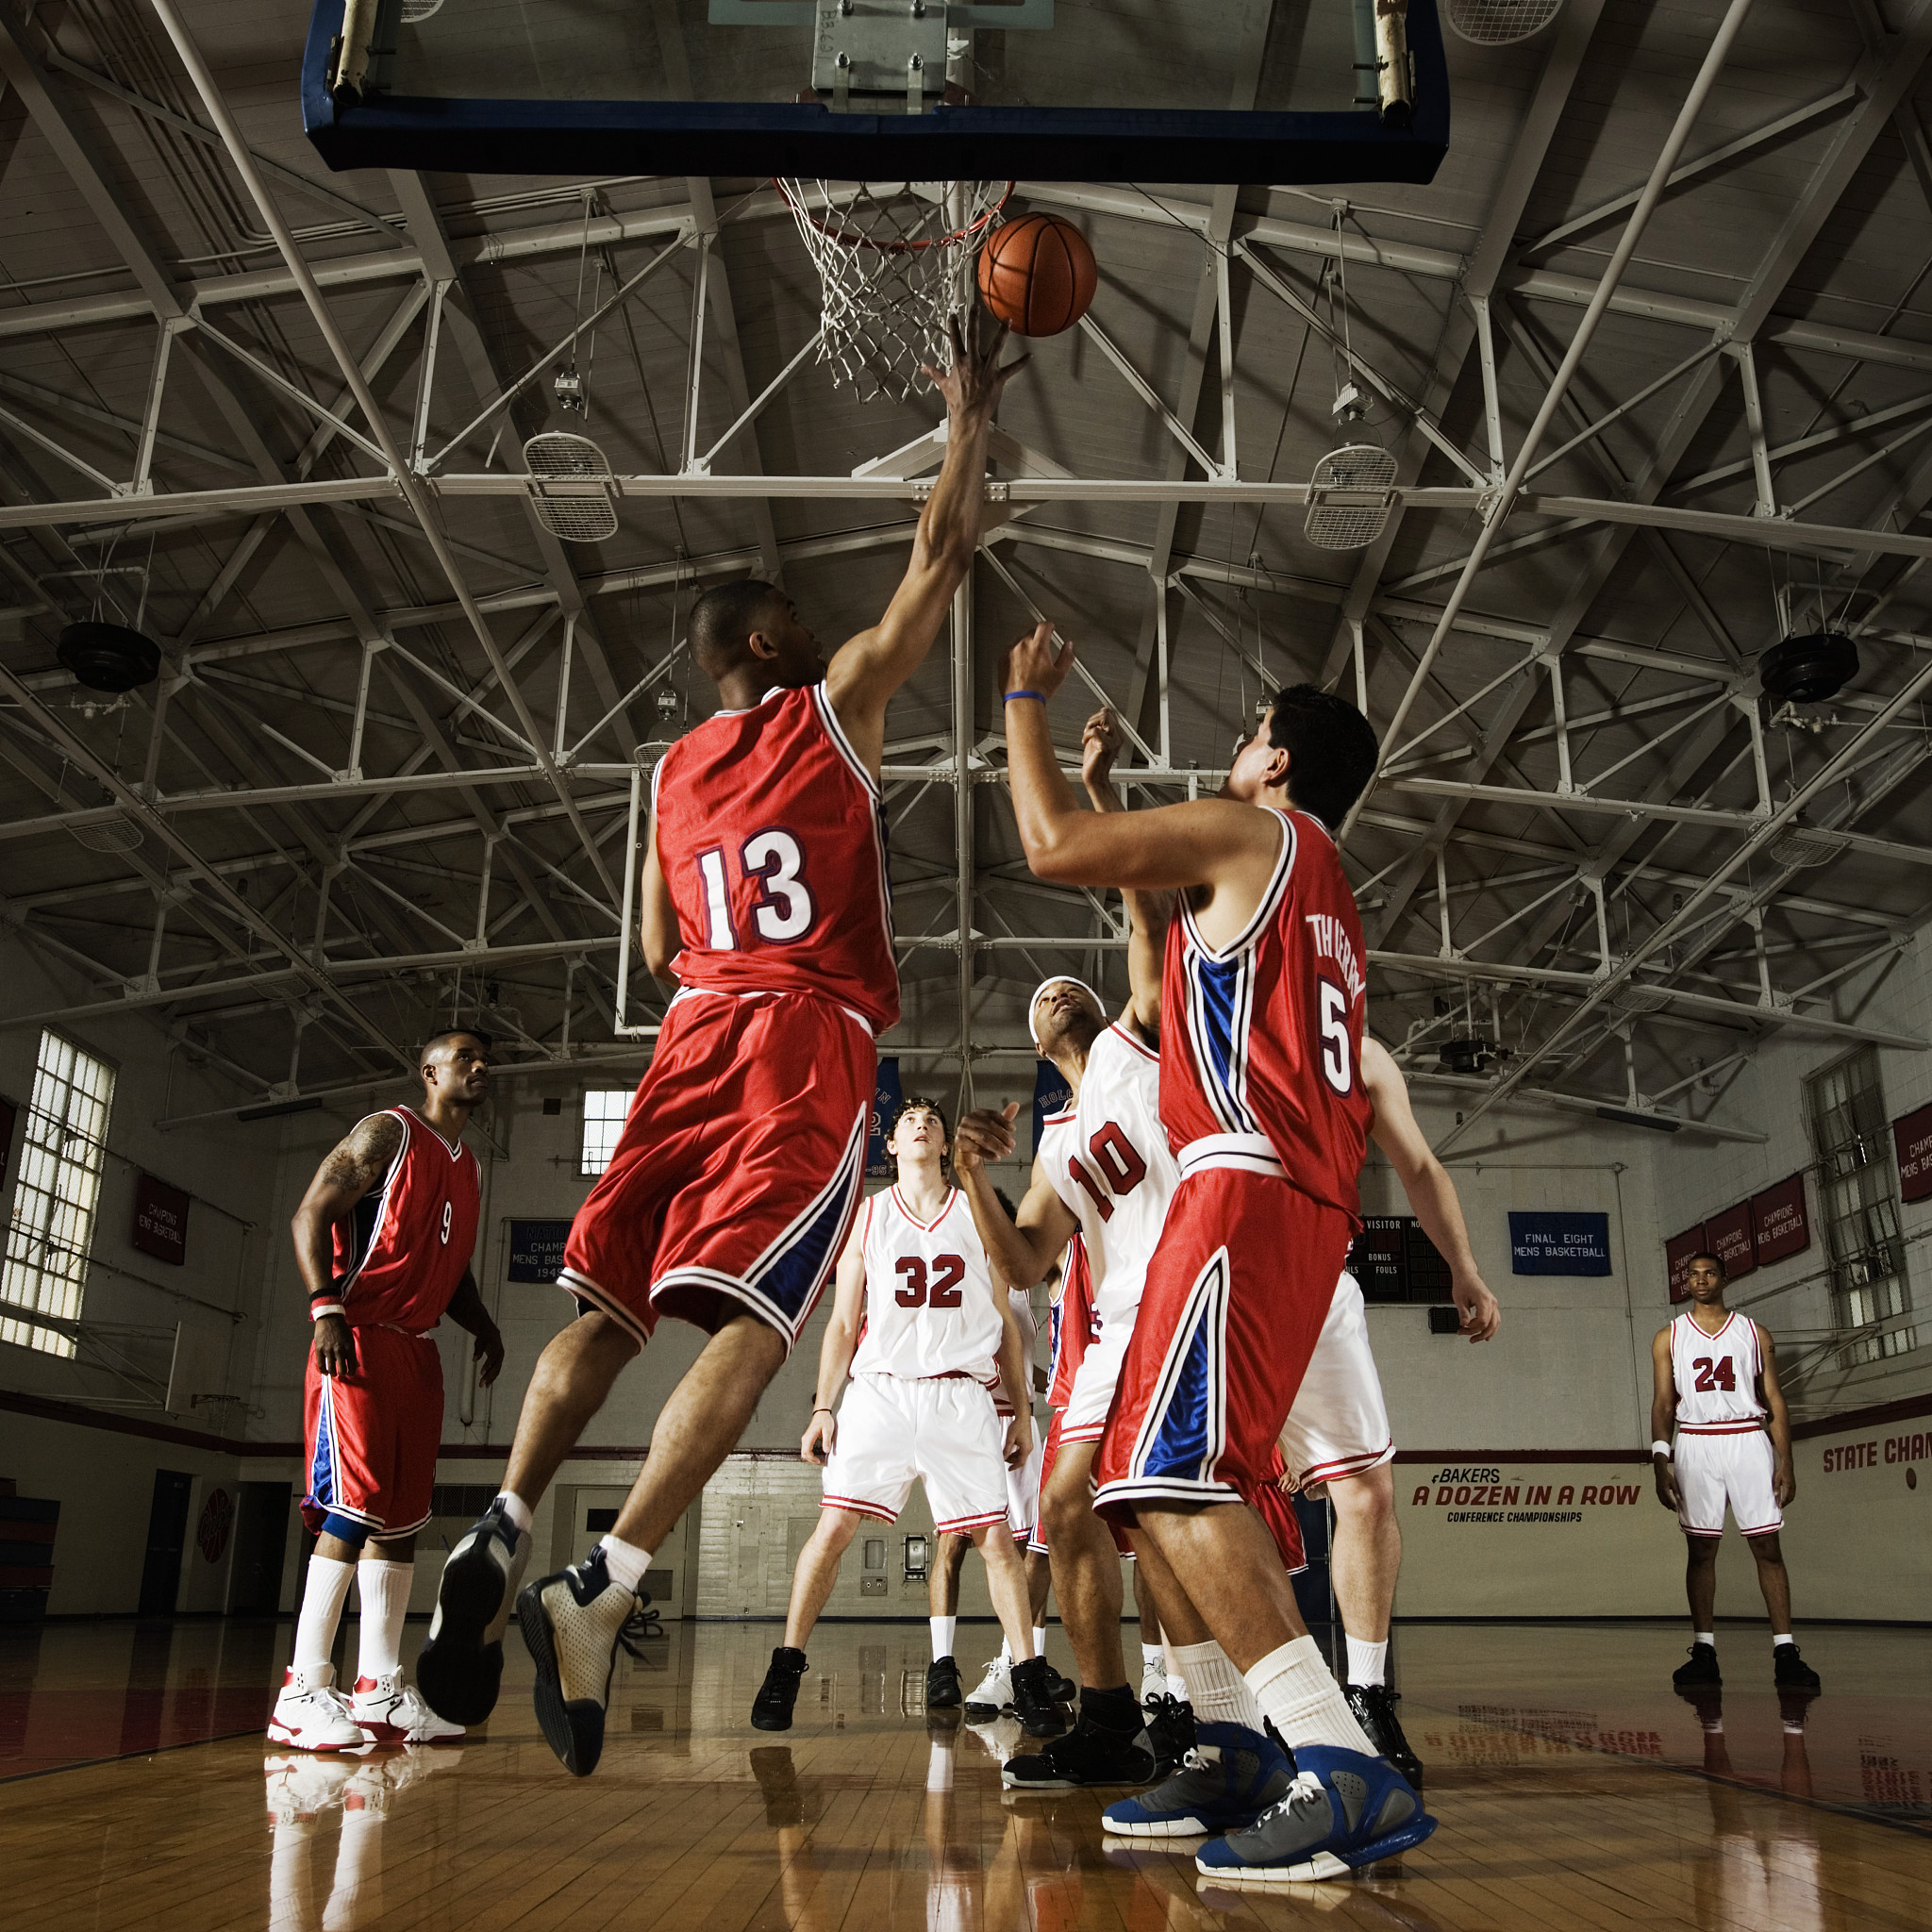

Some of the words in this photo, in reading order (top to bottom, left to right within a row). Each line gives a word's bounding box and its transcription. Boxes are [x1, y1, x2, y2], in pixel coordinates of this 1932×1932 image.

[696, 825, 818, 951] 13
[1317, 974, 1352, 1099] 5
[1068, 1121, 1147, 1224] 10
[441, 1200, 452, 1245] 9
[1367, 1220, 1401, 1229] VISITOR
[1764, 1204, 1793, 1227] CHAMPIONS
[1772, 1214, 1804, 1240] BASKETBALL
[1525, 1234, 1556, 1243] FINAL
[1563, 1234, 1593, 1243] EIGHT
[1716, 1228, 1743, 1251] CHAMPIONS
[512, 1254, 538, 1265] MENS
[1368, 1253, 1391, 1261] BONUS
[1514, 1247, 1540, 1257] MENS
[1545, 1247, 1606, 1257] BASKETBALL
[894, 1254, 966, 1308] 32
[1692, 1356, 1736, 1392] 24
[1824, 1441, 1877, 1473] STATE
[1439, 1468, 1500, 1484] BAKERS
[1412, 1486, 1430, 1506] A
[1435, 1486, 1521, 1506] DOZEN
[1524, 1486, 1552, 1506] IN
[1557, 1486, 1574, 1506] A
[1580, 1486, 1641, 1506] ROW
[1447, 1512, 1504, 1523] CONFERENCE
[1507, 1512, 1582, 1523] CHAMPIONSHIPS
